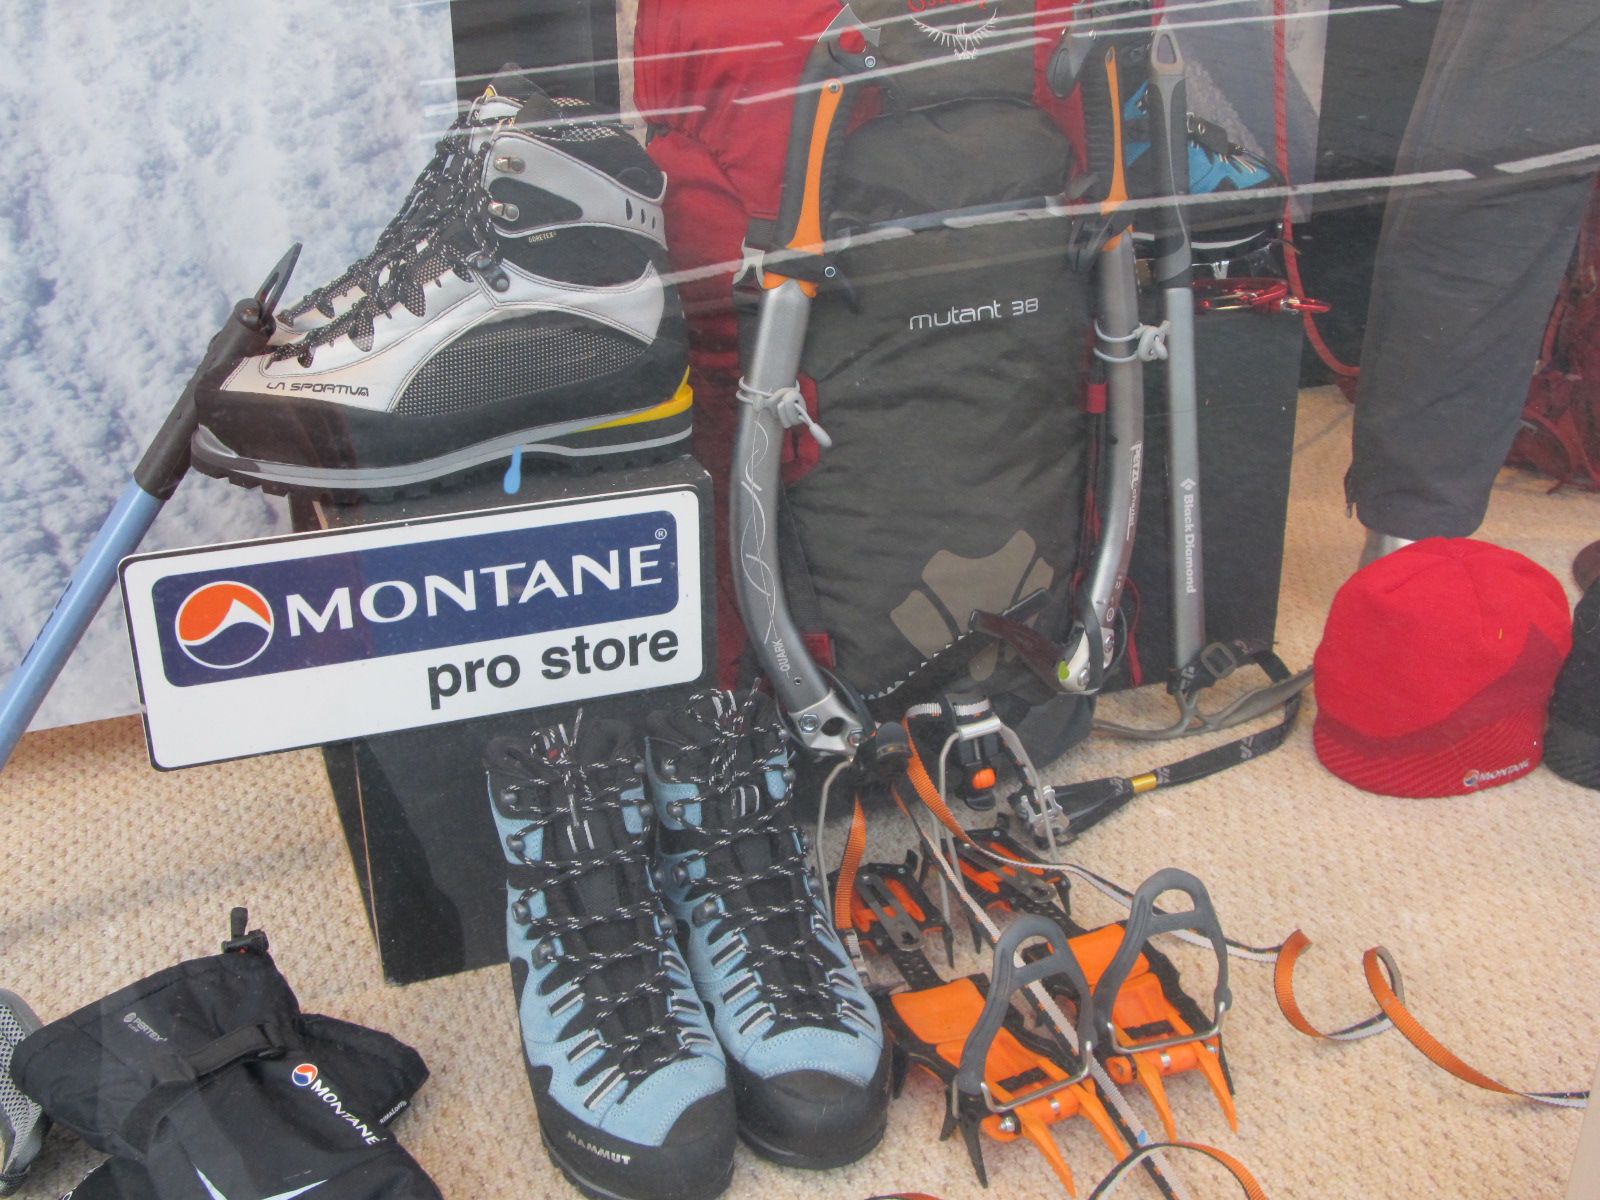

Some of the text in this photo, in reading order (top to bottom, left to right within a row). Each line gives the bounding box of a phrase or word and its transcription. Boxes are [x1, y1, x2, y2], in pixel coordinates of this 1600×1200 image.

[909, 298, 1039, 330] mutant 38
[290, 382, 369, 397] SPORTIVA
[1183, 493, 1197, 594] Black Diamond
[286, 543, 662, 638] MONTANE
[427, 628, 680, 711] pro store
[771, 638, 790, 672] QUARK
[310, 1078, 381, 1145] MONTANE
[566, 1130, 631, 1165] MAMMUT
